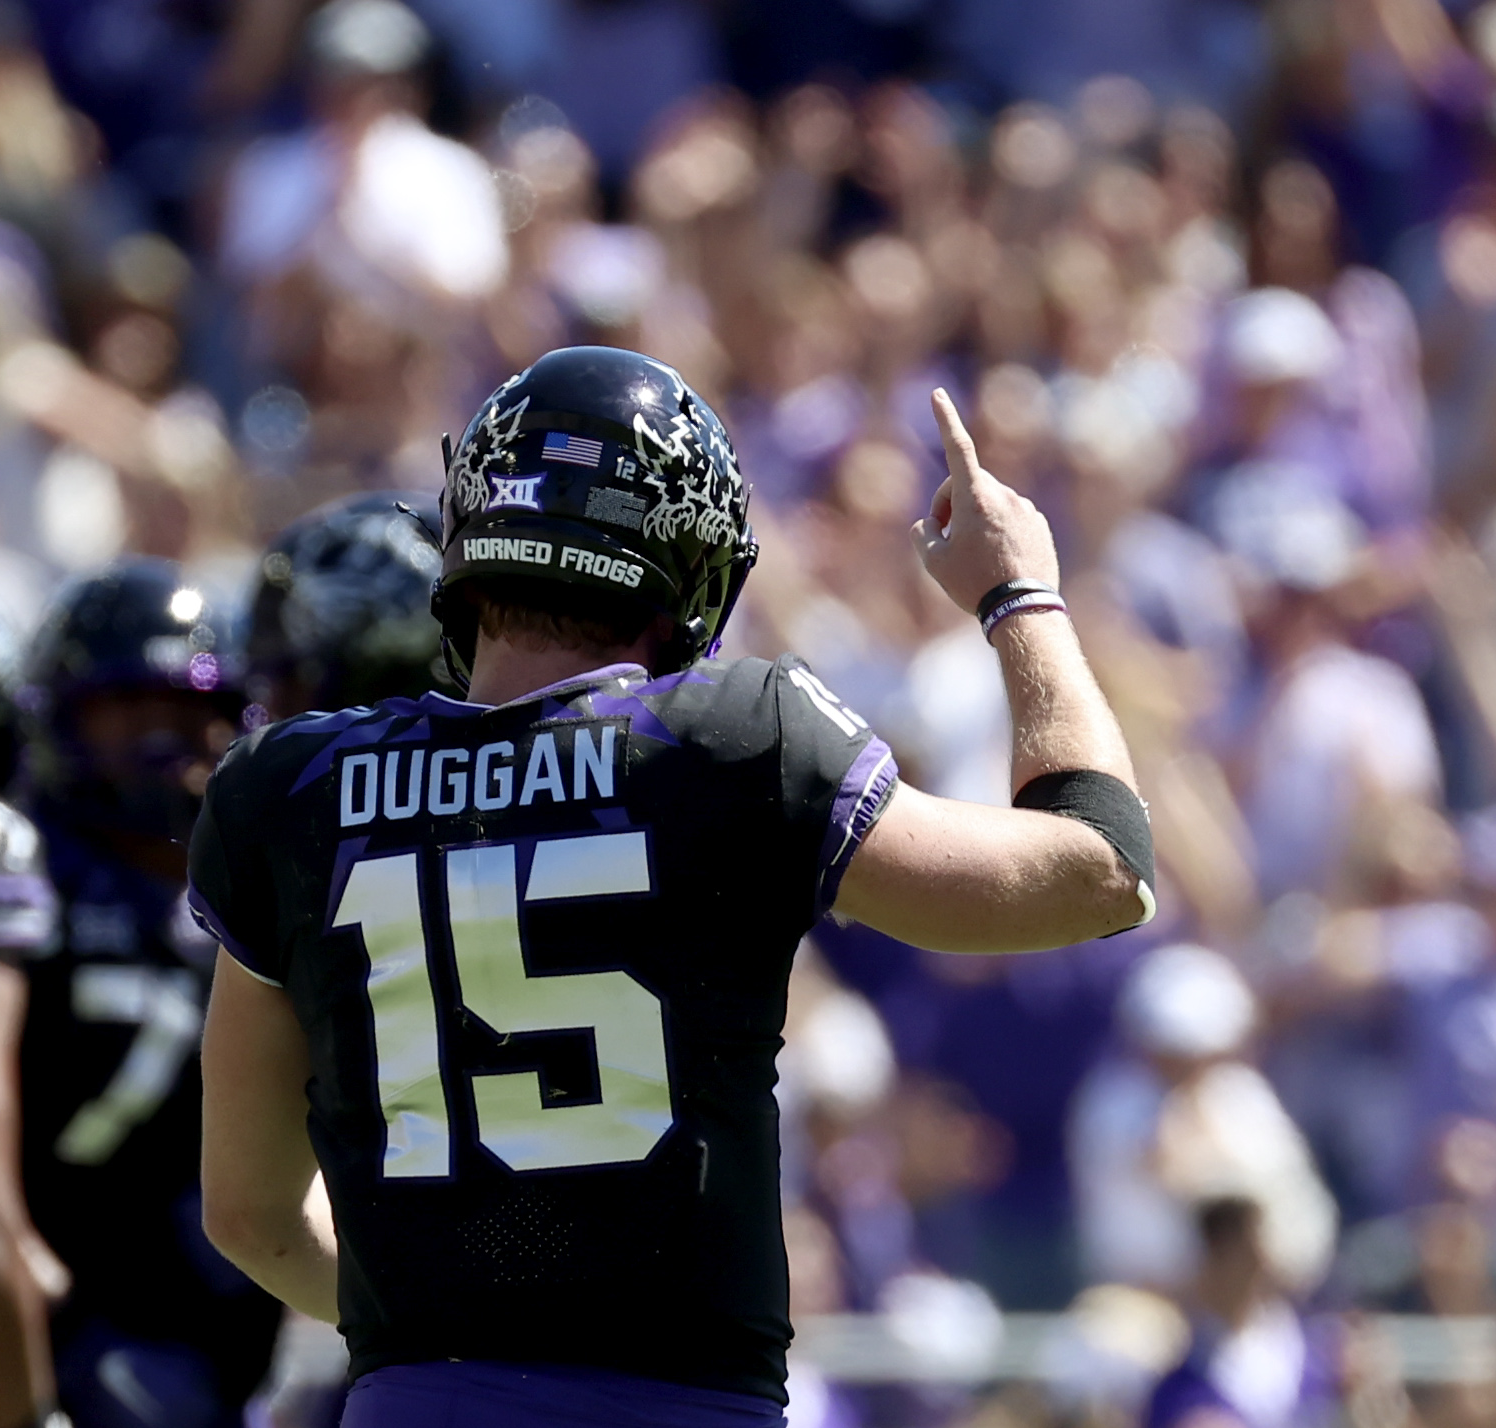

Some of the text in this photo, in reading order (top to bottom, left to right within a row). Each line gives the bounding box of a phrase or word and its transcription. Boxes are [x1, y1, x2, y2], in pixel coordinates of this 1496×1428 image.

[488, 476, 543, 511] XII
[615, 456, 638, 482] 12
[462, 537, 645, 589] HORNED FROGS
[339, 725, 617, 828] DUGGAN
[331, 830, 675, 1179] 15
